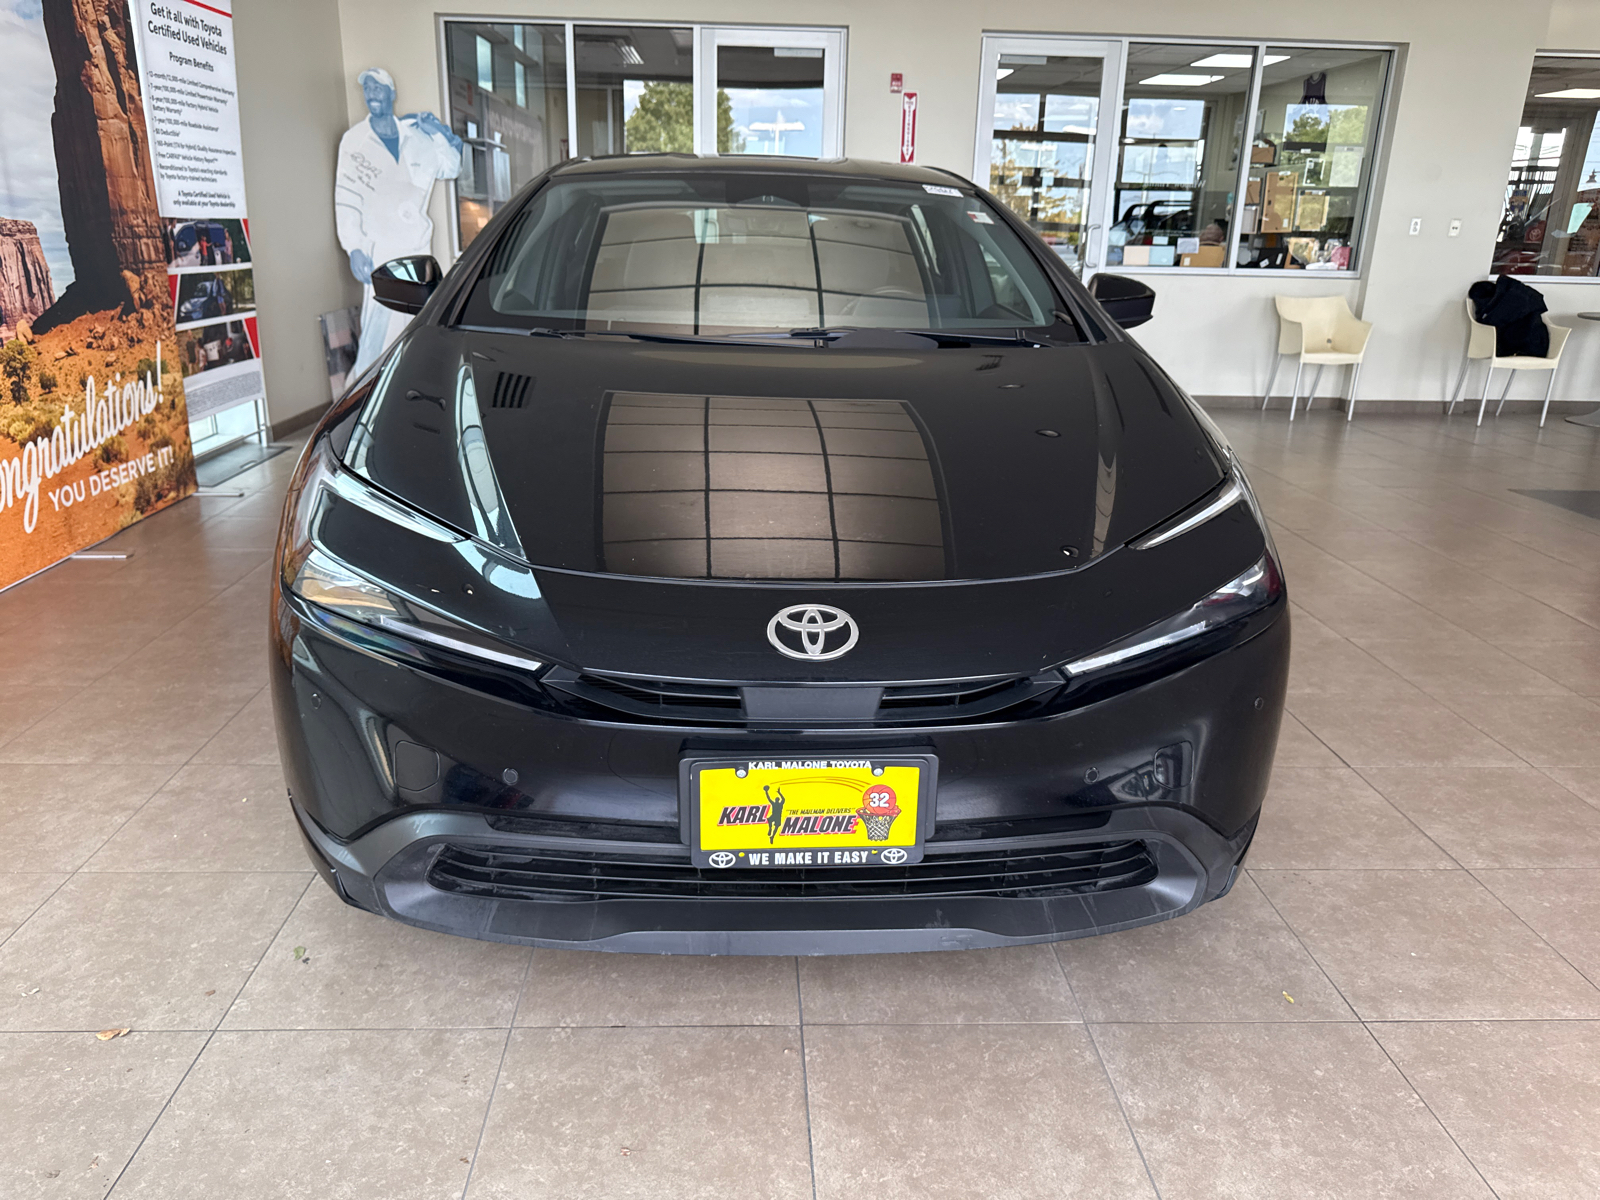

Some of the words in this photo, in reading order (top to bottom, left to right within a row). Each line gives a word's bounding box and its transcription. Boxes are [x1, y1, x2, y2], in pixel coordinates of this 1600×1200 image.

[150, 2, 165, 18] Get
[166, 7, 172, 21] it
[173, 10, 183, 24] all
[183, 15, 200, 30] with
[200, 20, 222, 37] Toyota
[148, 20, 181, 41] Certified
[181, 31, 200, 47] Used
[200, 37, 227, 56] Vehicles
[169, 51, 192, 66] Program
[193, 58, 214, 72] Benefits
[48, 480, 85, 512] YOU
[89, 452, 156, 497] DESERVE
[158, 445, 175, 468] IT!
[781, 761, 828, 769] MALONE
[830, 761, 872, 769] TOYOTA
[869, 792, 890, 808] 32
[717, 804, 771, 827] KARL
[780, 815, 860, 836] MALONE
[749, 854, 769, 865] WE
[775, 852, 813, 865] MAKE
[817, 852, 829, 864] IT
[834, 851, 869, 864] EASY
